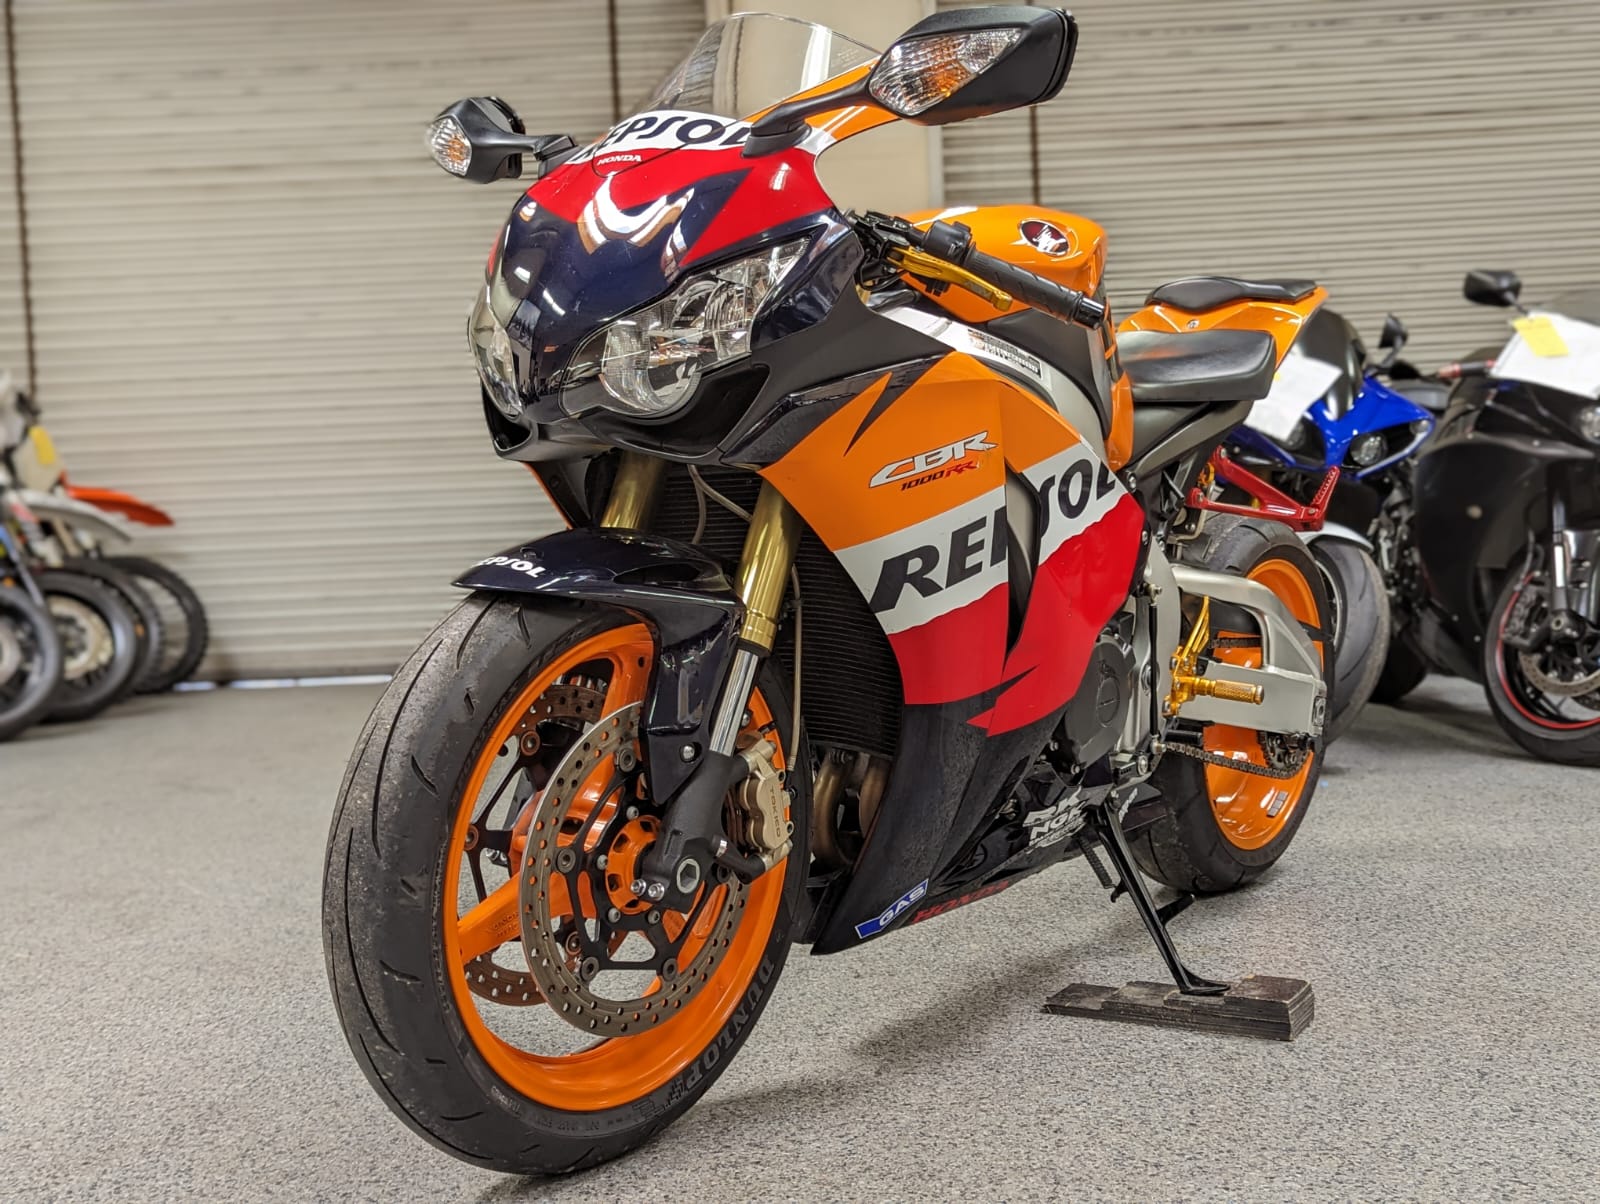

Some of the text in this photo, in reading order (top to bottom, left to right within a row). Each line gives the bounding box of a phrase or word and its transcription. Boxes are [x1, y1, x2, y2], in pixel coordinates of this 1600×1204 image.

[597, 155, 642, 166] HONDA
[869, 431, 999, 488] CBR
[769, 785, 781, 838] TOKICO
[879, 886, 925, 926] GAS
[686, 955, 775, 1089] DUNLOP
